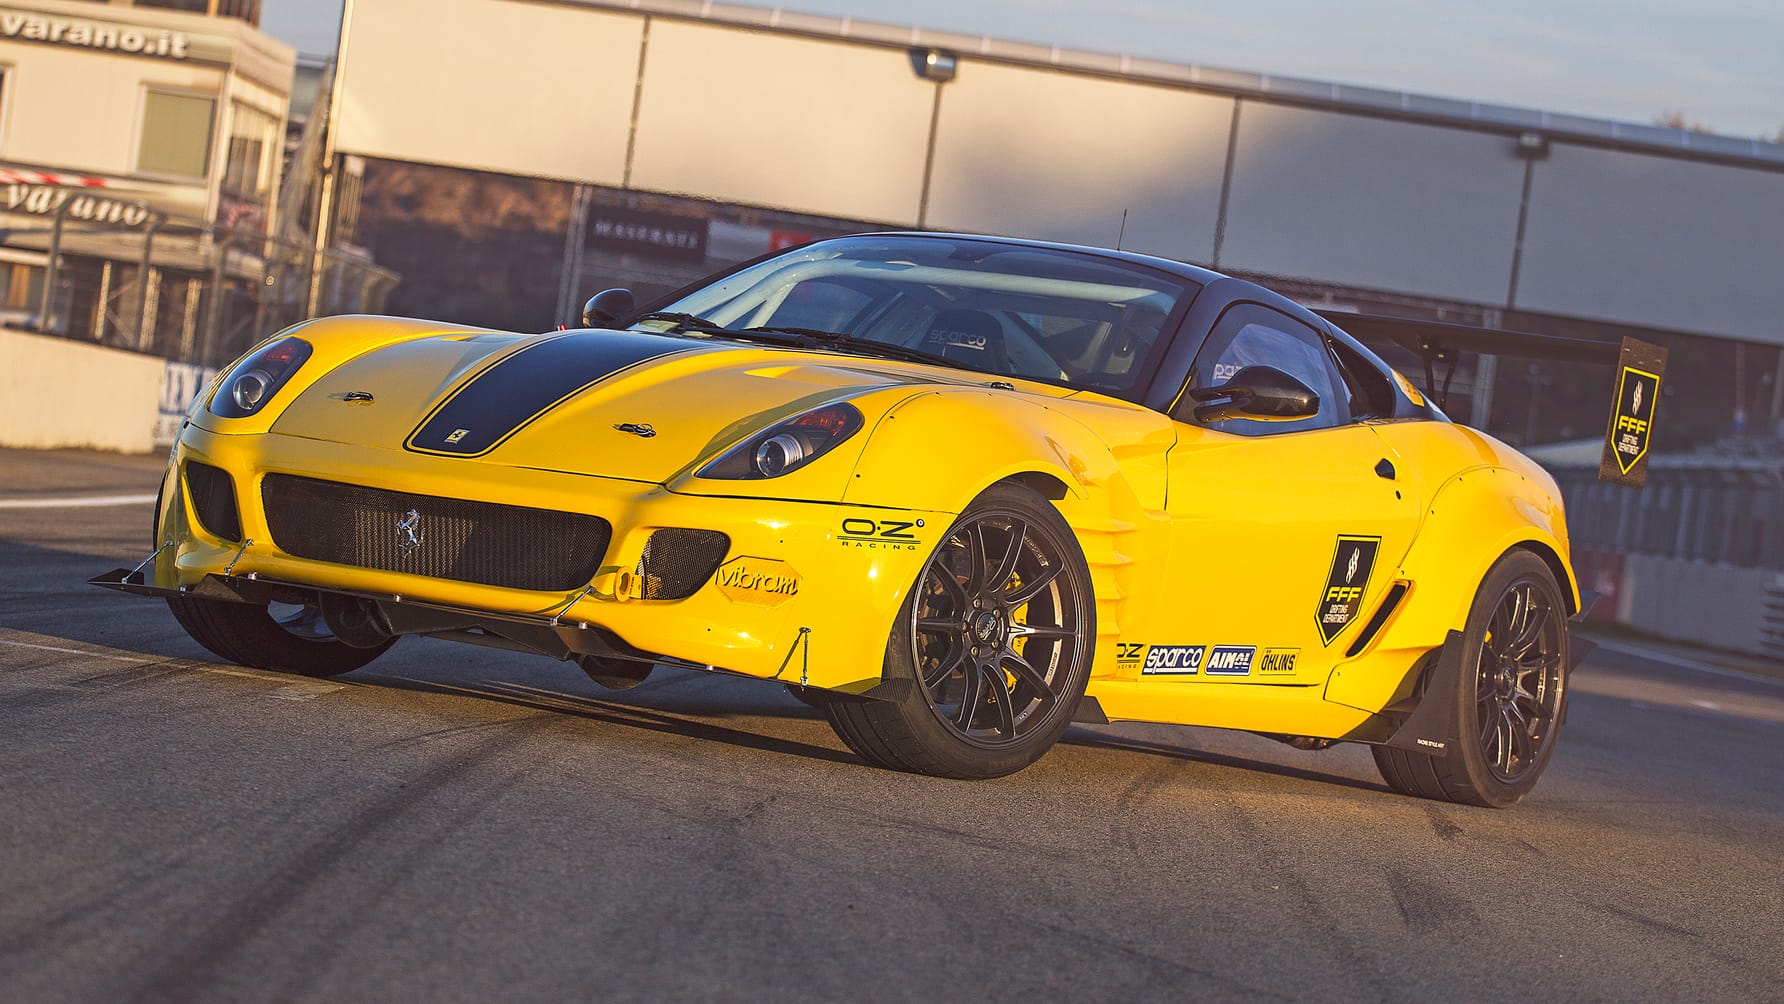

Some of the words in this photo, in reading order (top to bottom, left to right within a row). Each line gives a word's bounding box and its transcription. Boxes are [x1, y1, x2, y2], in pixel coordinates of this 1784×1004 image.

[0, 13, 189, 59] varano.it
[1618, 414, 1648, 434] FFF
[841, 541, 917, 551] RACING
[722, 566, 799, 596] vibram
[1325, 586, 1362, 602] FFF
[1146, 648, 1203, 675] sparco
